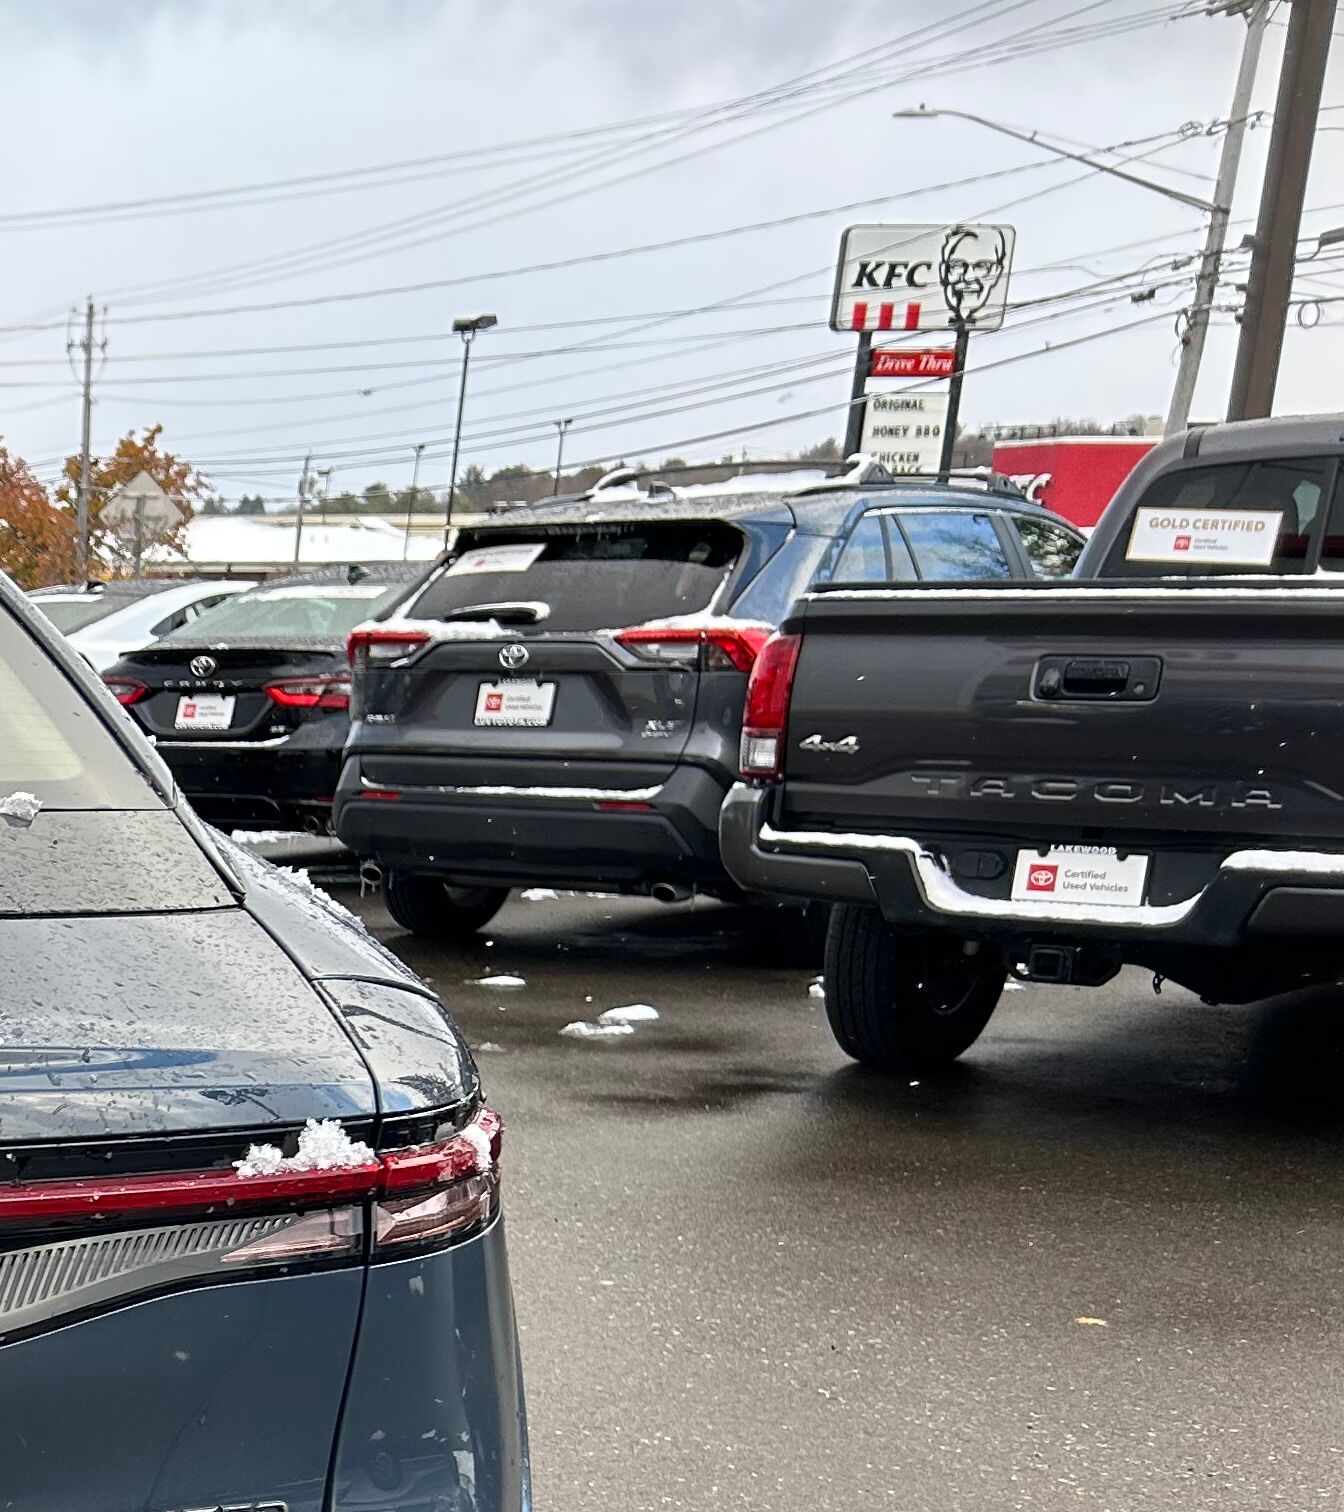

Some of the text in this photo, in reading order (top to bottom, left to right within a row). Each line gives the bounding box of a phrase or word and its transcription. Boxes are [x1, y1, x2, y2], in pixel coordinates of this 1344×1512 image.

[851, 261, 932, 288] KFC
[877, 354, 953, 372] Drive Thru
[873, 398, 924, 411] ORIGINAL
[872, 424, 909, 438] HONEY
[1149, 517, 1266, 532] GOLD CERTIFIED
[799, 734, 860, 754] 4x4
[911, 774, 1282, 809] TACOMA
[1050, 844, 1117, 855] LAKEWOOD
[1064, 869, 1107, 880] Certified
[1062, 881, 1128, 893] Used Vehicles
